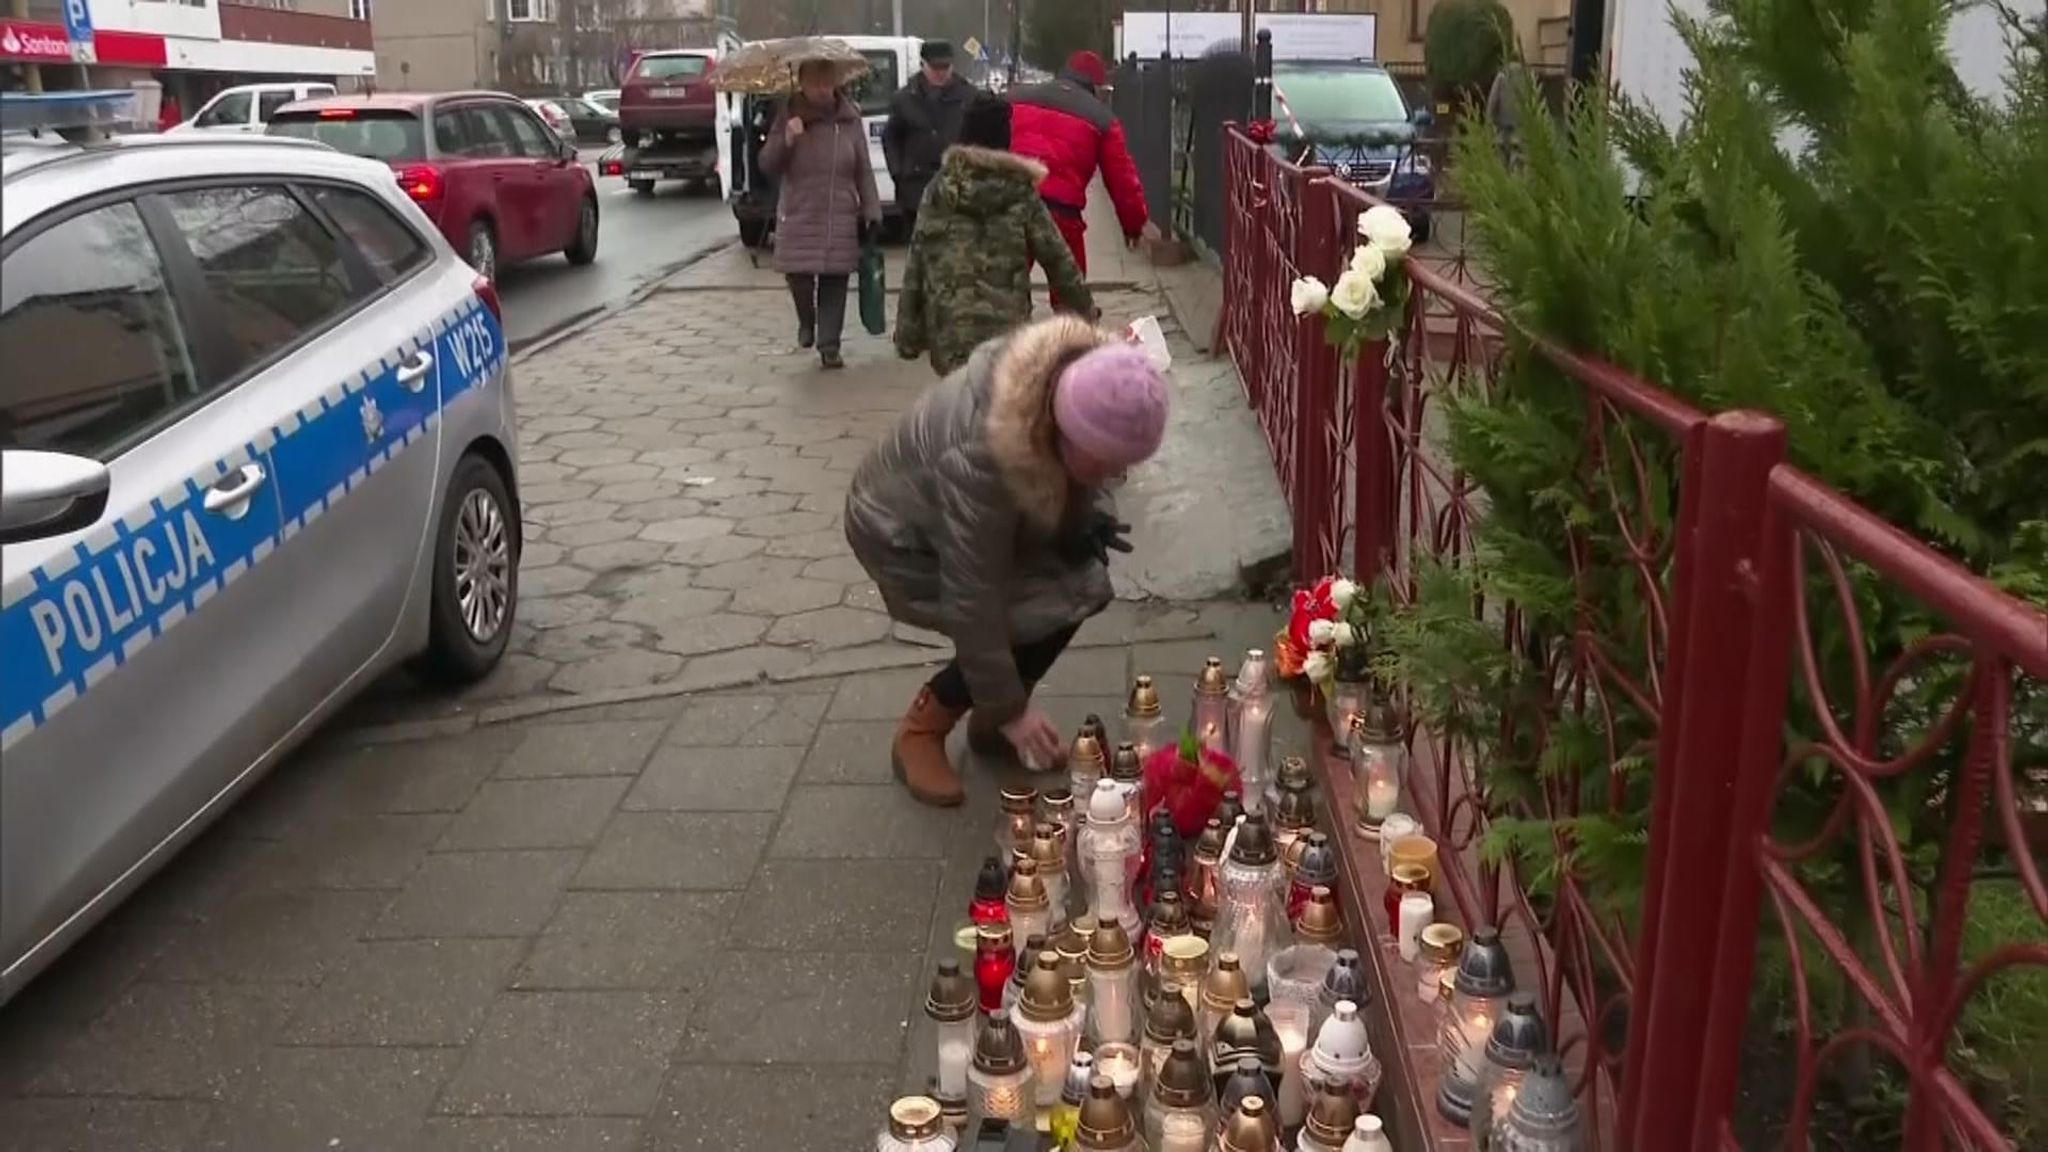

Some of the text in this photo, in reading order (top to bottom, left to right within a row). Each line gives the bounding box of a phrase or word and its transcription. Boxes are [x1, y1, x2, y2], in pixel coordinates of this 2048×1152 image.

[67, 0, 85, 28] P
[20, 33, 71, 54] Santan
[446, 311, 493, 379] W215
[30, 509, 215, 676] POLICJA
